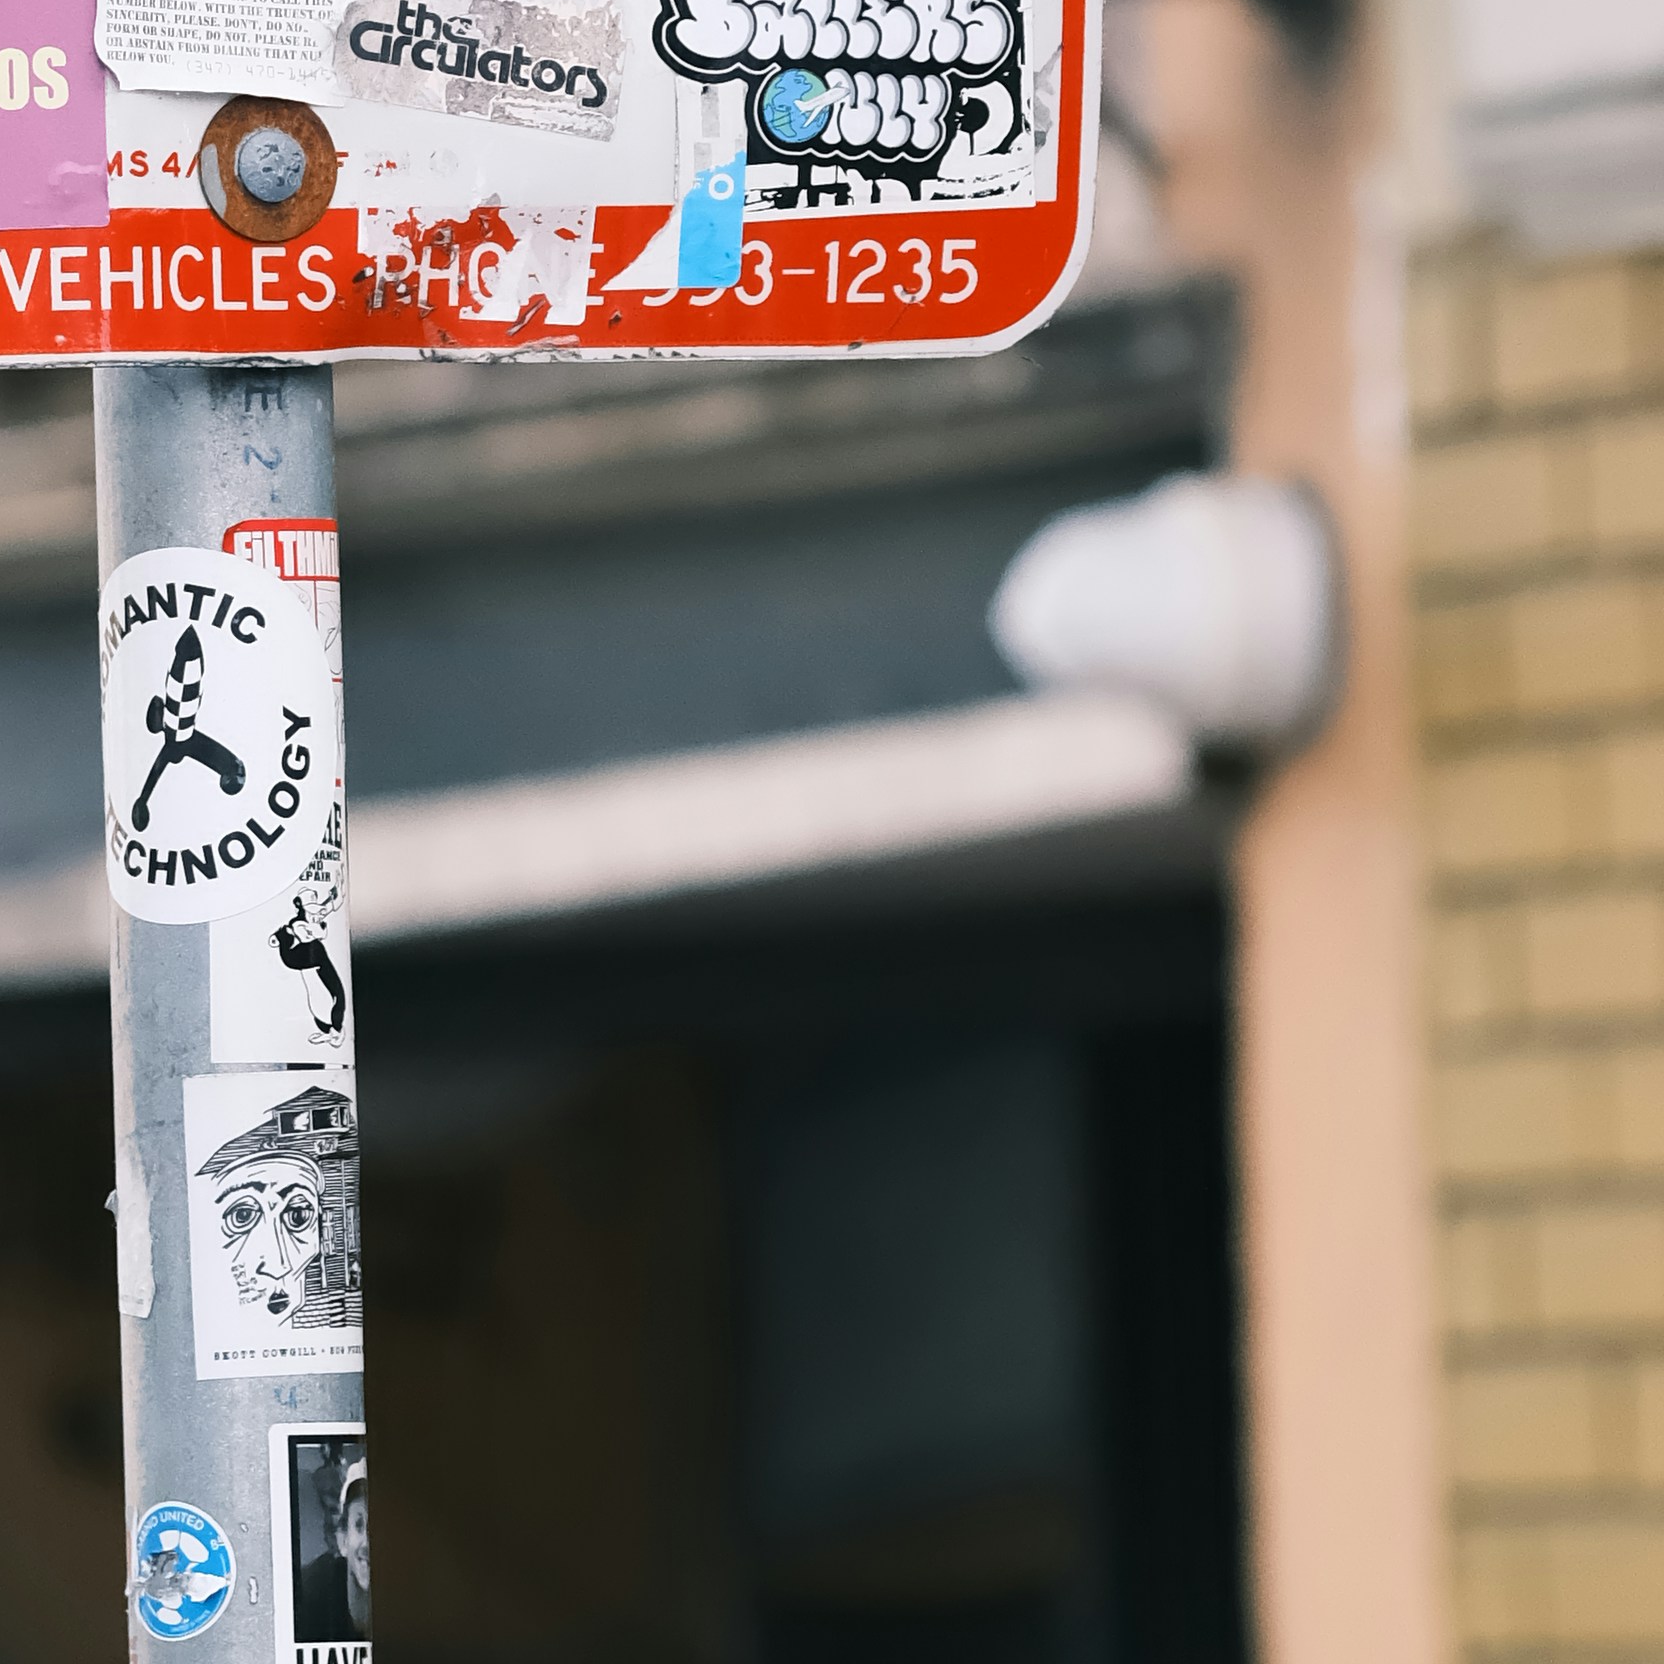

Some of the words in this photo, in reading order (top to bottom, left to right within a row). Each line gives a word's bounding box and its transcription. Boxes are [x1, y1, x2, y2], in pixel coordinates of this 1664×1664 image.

[205, 2, 235, 14] WITH
[239, 5, 263, 16] THE
[267, 7, 316, 20] TRUEST
[106, 23, 140, 34] FORM
[142, 25, 157, 36] OR
[206, 30, 221, 40] DO
[255, 34, 300, 47] PLEASE
[266, 21, 282, 31] DO
[106, 50, 146, 62] BELOW
[126, 38, 174, 51] ABSTAIN
[178, 42, 210, 54] FROM
[214, 44, 260, 57] DIALING
[264, 48, 297, 60] THAT
